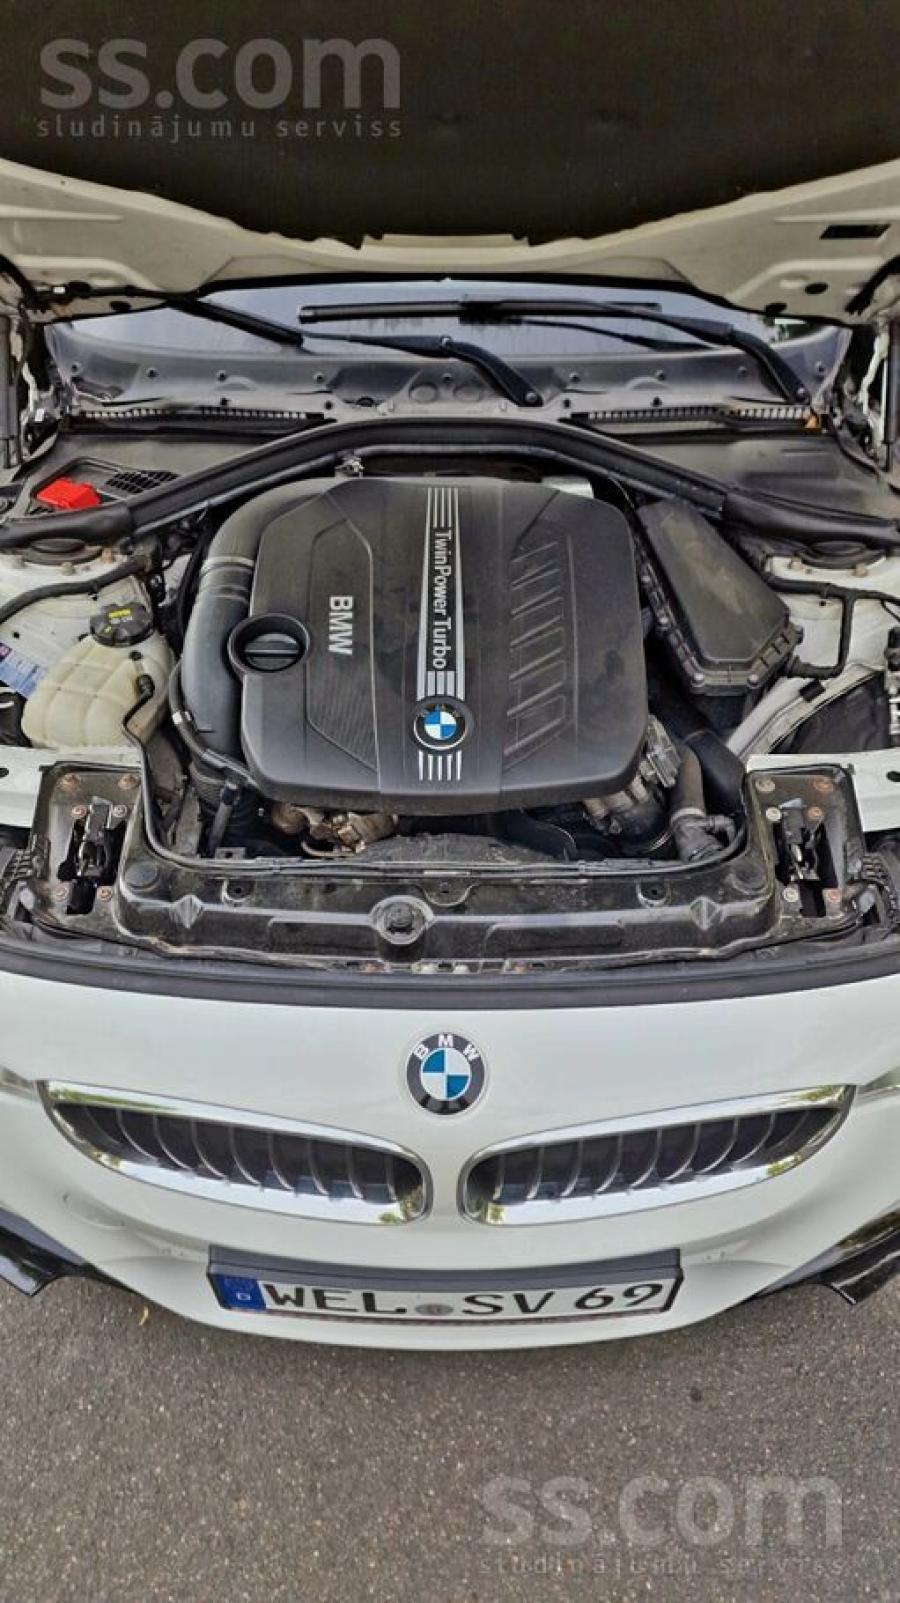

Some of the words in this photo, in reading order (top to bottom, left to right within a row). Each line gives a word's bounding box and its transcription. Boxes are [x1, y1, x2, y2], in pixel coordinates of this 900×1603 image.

[432, 530, 452, 615] TwinPower
[328, 595, 354, 656] BMW
[432, 617, 452, 671] Turbo
[413, 1033, 481, 1062] BMW
[263, 1283, 408, 1314] WEL
[462, 1290, 556, 1315] SV
[574, 1282, 664, 1310] 69
